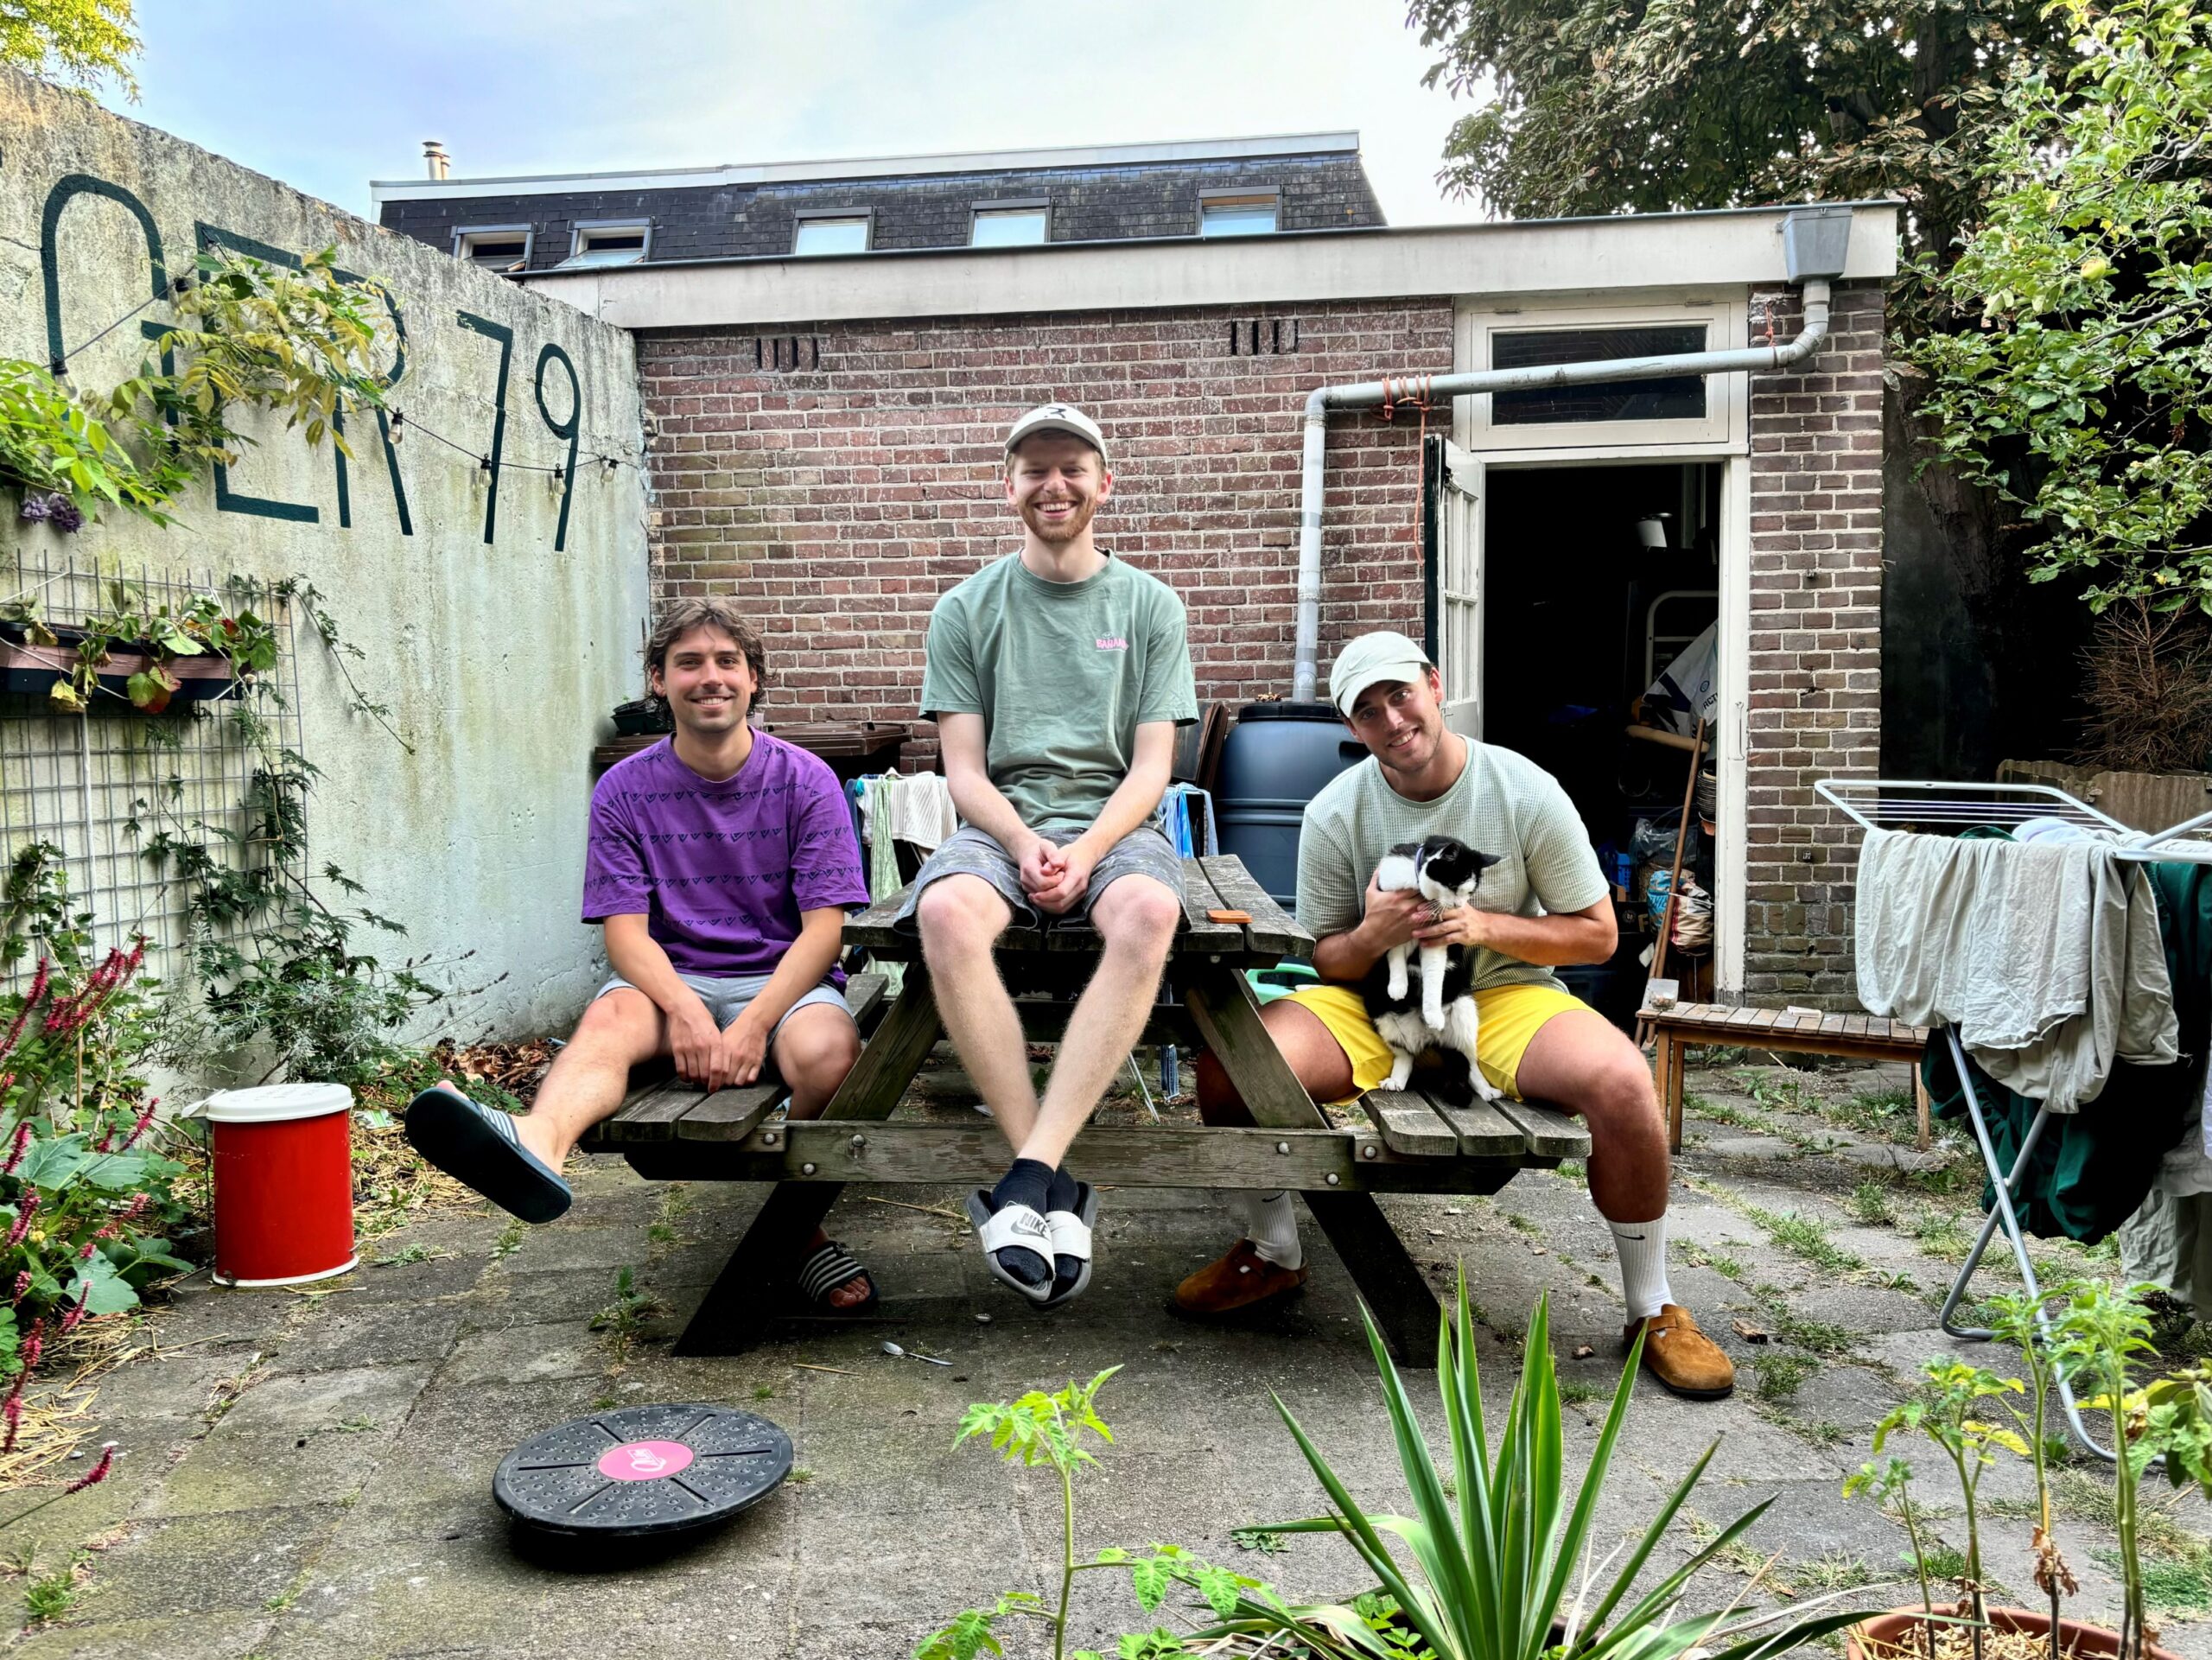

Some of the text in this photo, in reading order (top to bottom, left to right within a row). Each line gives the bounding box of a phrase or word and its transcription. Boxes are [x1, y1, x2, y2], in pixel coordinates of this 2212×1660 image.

[0, 147, 582, 551] GER 79
[1020, 1212, 1047, 1238] NIKE
